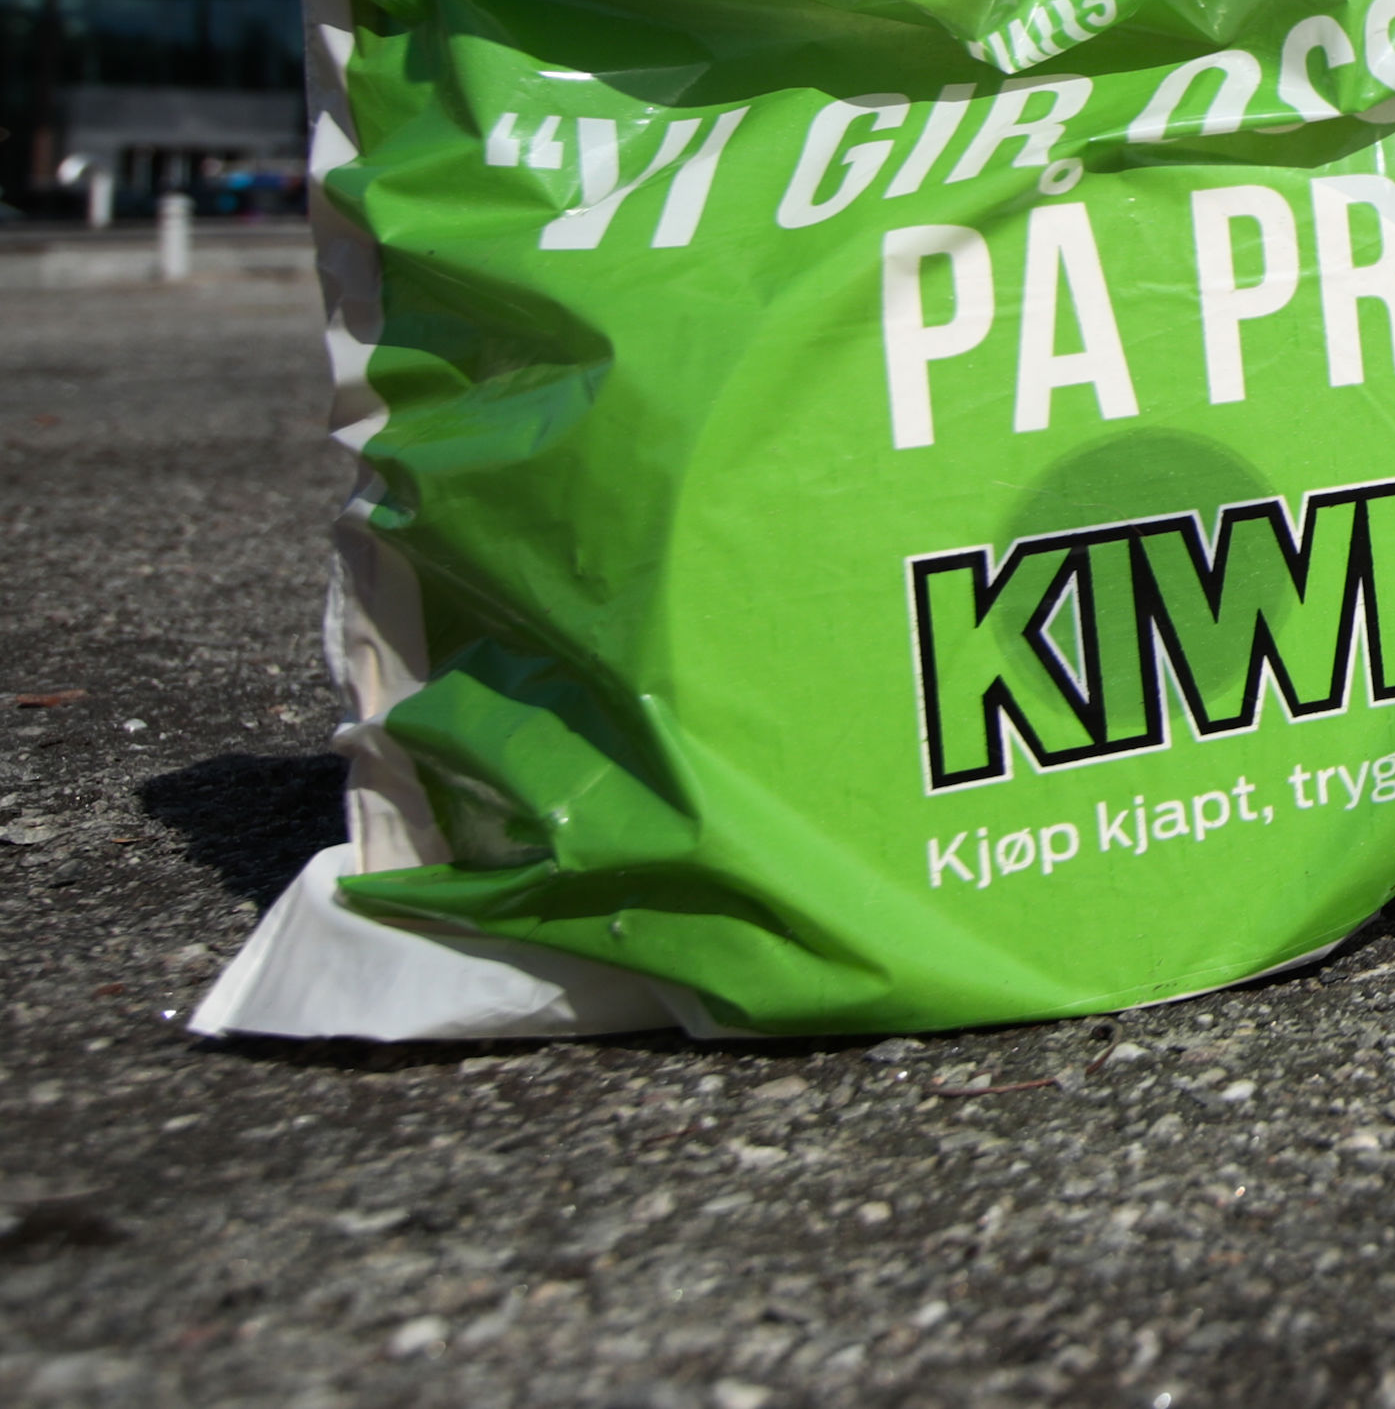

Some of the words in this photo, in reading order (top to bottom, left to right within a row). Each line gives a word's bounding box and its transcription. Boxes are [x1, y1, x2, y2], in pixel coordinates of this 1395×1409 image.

[776, 73, 1094, 230] GIR
[880, 156, 1141, 450] PÅ
[926, 820, 1081, 890] Kjøp
[1095, 776, 1274, 857] kjapt,
